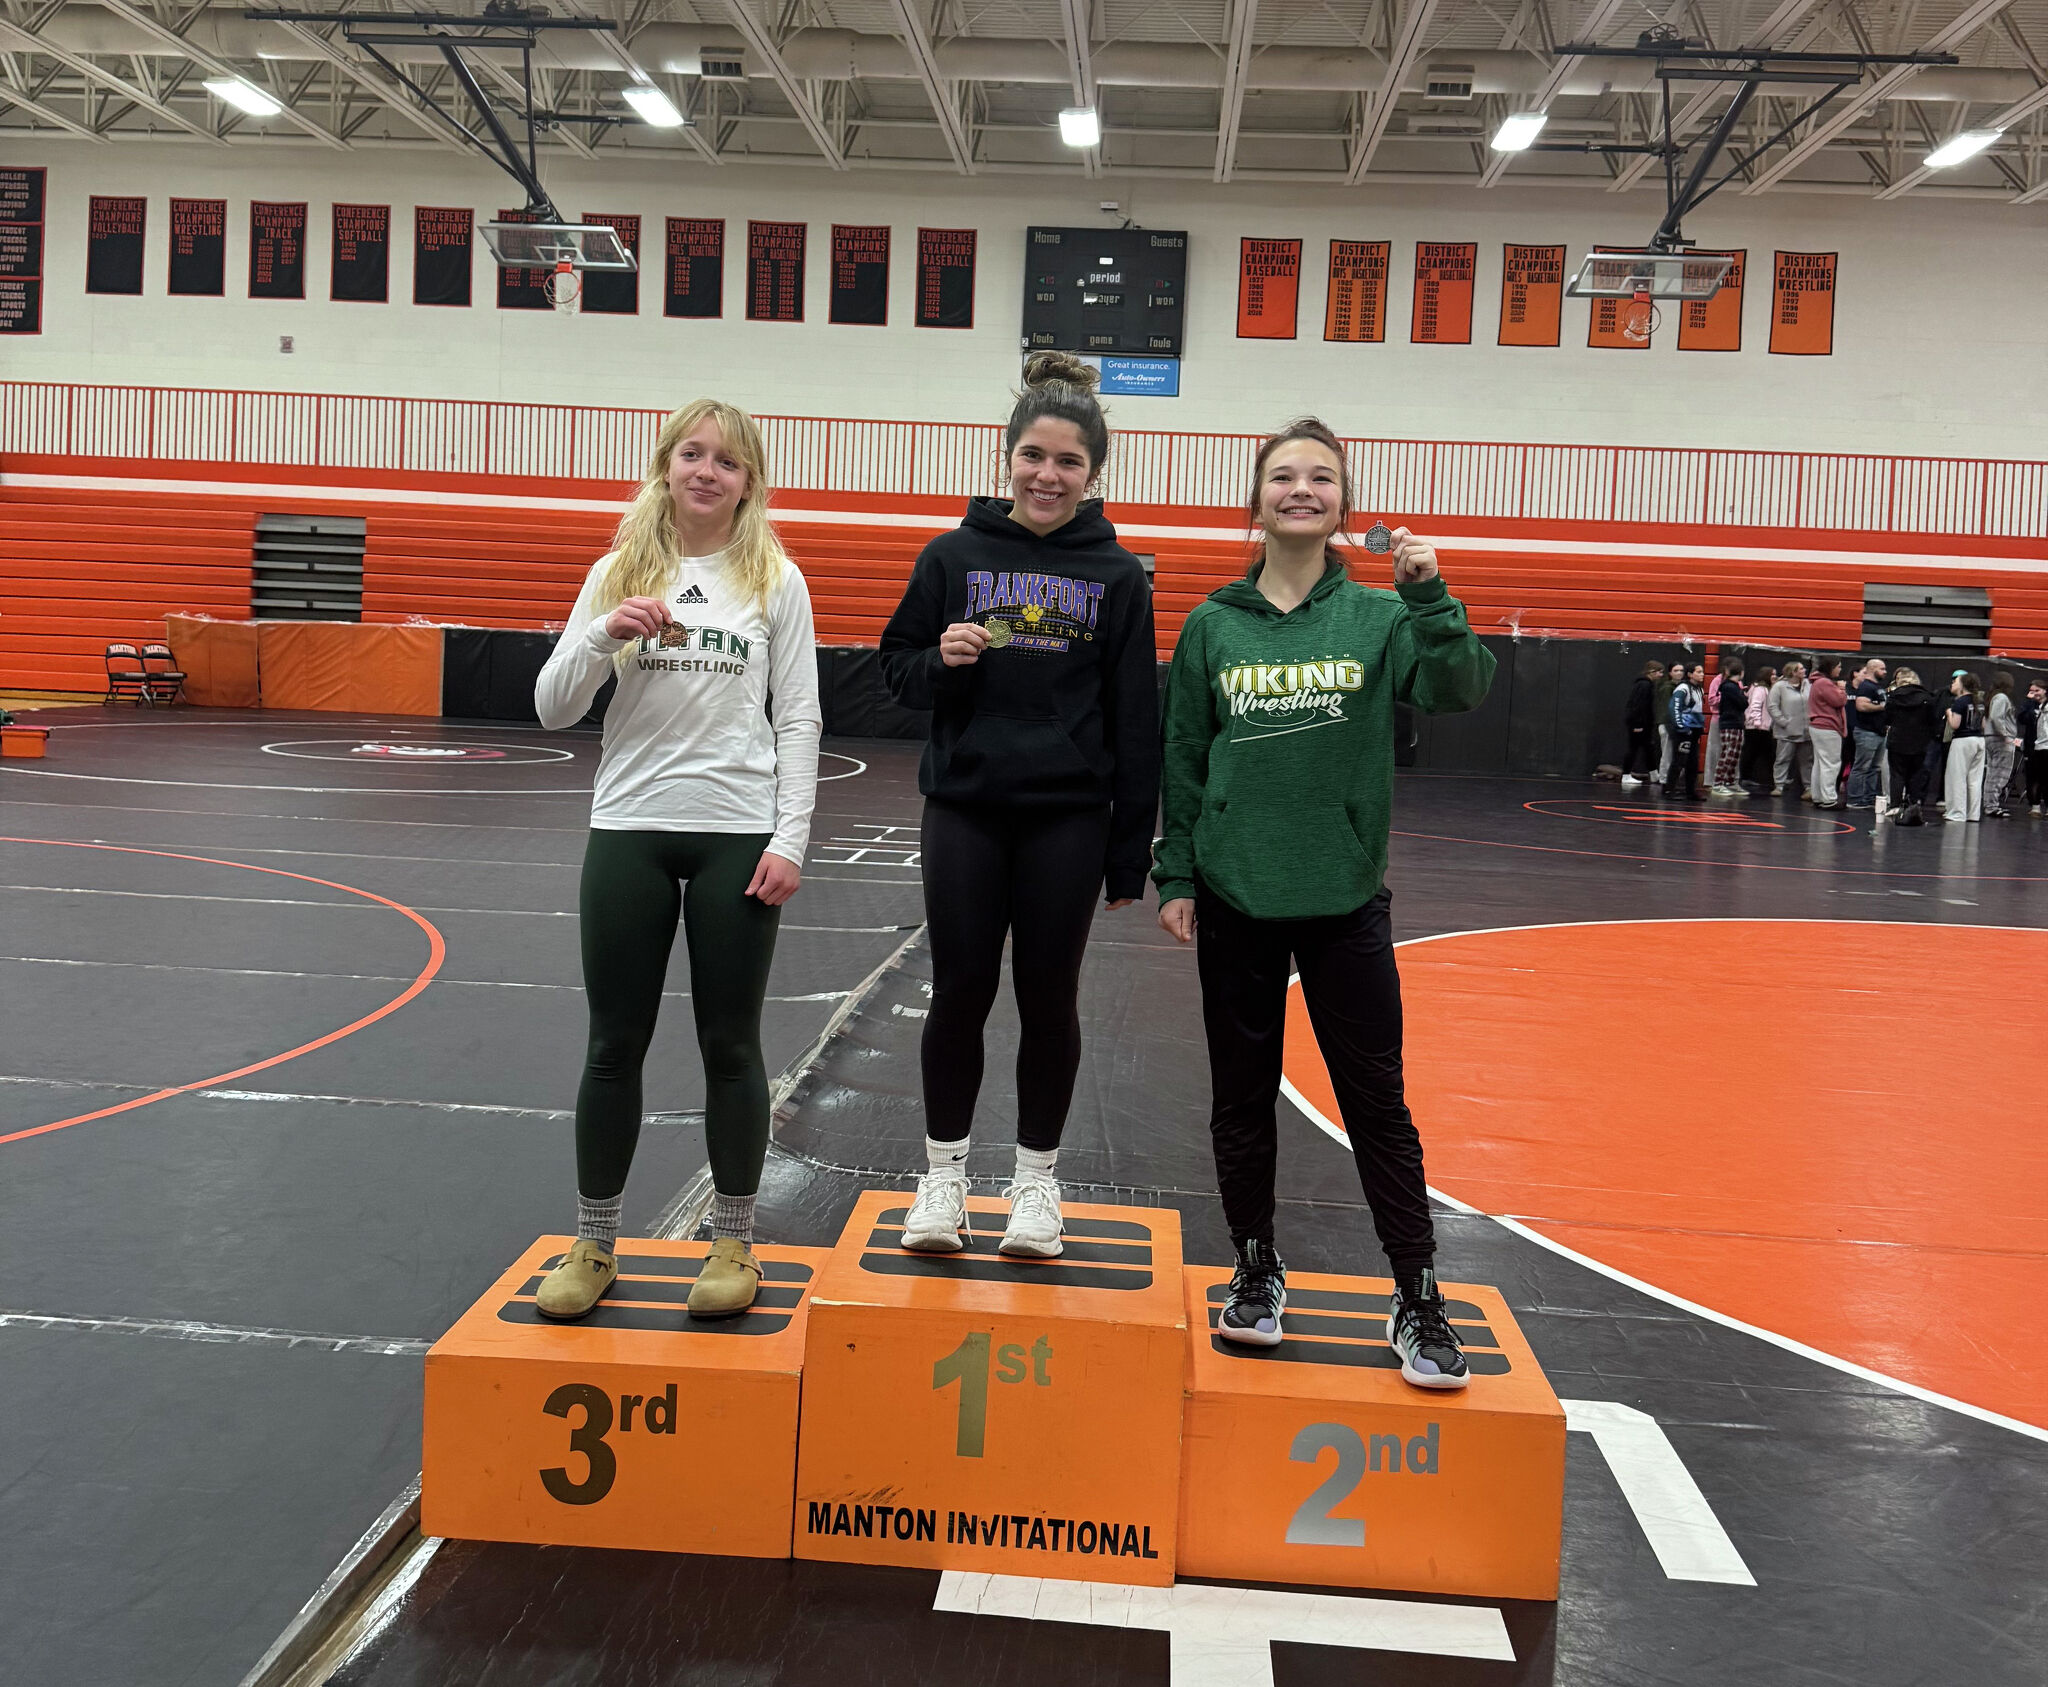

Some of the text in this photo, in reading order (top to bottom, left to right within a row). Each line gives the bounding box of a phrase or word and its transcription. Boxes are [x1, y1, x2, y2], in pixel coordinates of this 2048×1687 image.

[92, 200, 142, 211] CONFERENCE
[173, 202, 224, 214] CONFERENCE
[254, 205, 304, 217] CONFERENCE
[93, 211, 142, 222] CHAMPIONS
[174, 213, 222, 225] CHAMPIONS
[336, 207, 387, 219] CONFERENCE
[419, 210, 470, 222] CONFERENCE
[255, 216, 303, 228] CHAMPIONS
[337, 219, 385, 231] CHAMPIONS
[420, 222, 469, 234] CHAMPIONS
[670, 221, 721, 233] CONFERENCE
[92, 223, 141, 234] VOLLEYBALL
[174, 225, 222, 236] WRESTLING
[265, 228, 292, 239] TRACK
[751, 224, 803, 237] CONFERENCE
[835, 228, 888, 240] CONFERENCE
[339, 230, 382, 242] SOFTBALL
[421, 233, 466, 245] FOOTBALL
[671, 233, 720, 245] CHAMPIONS
[921, 232, 973, 243] CONFERENCE
[1035, 231, 1060, 243] Home
[1151, 235, 1183, 248] Guests
[752, 236, 802, 249] CHAMPIONS
[836, 240, 886, 251] CHAMPIONS
[1250, 242, 1292, 253] DISTRICT
[688, 245, 720, 256] BASKETBALL
[770, 249, 801, 261] BASKETBALL
[922, 243, 972, 255] CHAMPIONS
[1339, 245, 1381, 256] DISTRICT
[1425, 246, 1467, 256] DISTRICT
[1514, 248, 1556, 259] DISTRICT
[853, 252, 885, 263] BASKETBALL
[923, 254, 969, 267] BASEBALL
[1246, 254, 1296, 265] CHAMPIONS
[1334, 256, 1384, 267] CHAMPIONS
[1420, 257, 1471, 268] CHAMPIONS
[1784, 256, 1827, 267] DISTRICT
[1246, 265, 1294, 276] BASEBALL
[1509, 260, 1560, 271] CHAMPIONS
[1090, 272, 1120, 284] period
[1352, 268, 1383, 279] BASKETBALL
[1439, 270, 1471, 280] BASKETBALL
[1527, 272, 1560, 283] BASKETBALL
[1779, 268, 1831, 279] CHAMPIONS
[1779, 279, 1831, 291] WRESTLING
[1036, 293, 1055, 302] won
[1156, 297, 1174, 306] won
[1033, 332, 1054, 344] fouls
[1089, 336, 1113, 346] game
[1149, 337, 1172, 348] fouls
[1107, 360, 1130, 369] Great
[1111, 372, 1166, 382] Auto-Owners
[964, 571, 1105, 630] FRANKFORT
[1036, 638, 1048, 646] THE
[1050, 639, 1065, 648] MAT
[637, 658, 745, 676] WRESTLING
[1218, 659, 1365, 699] VIKING
[1229, 686, 1347, 718] Wrestling
[933, 1332, 1053, 1458] 1st
[539, 1383, 678, 1505] 3rd
[1285, 1423, 1440, 1547] 2nd
[808, 1501, 1159, 1559] MANTON INVITATIONAL
